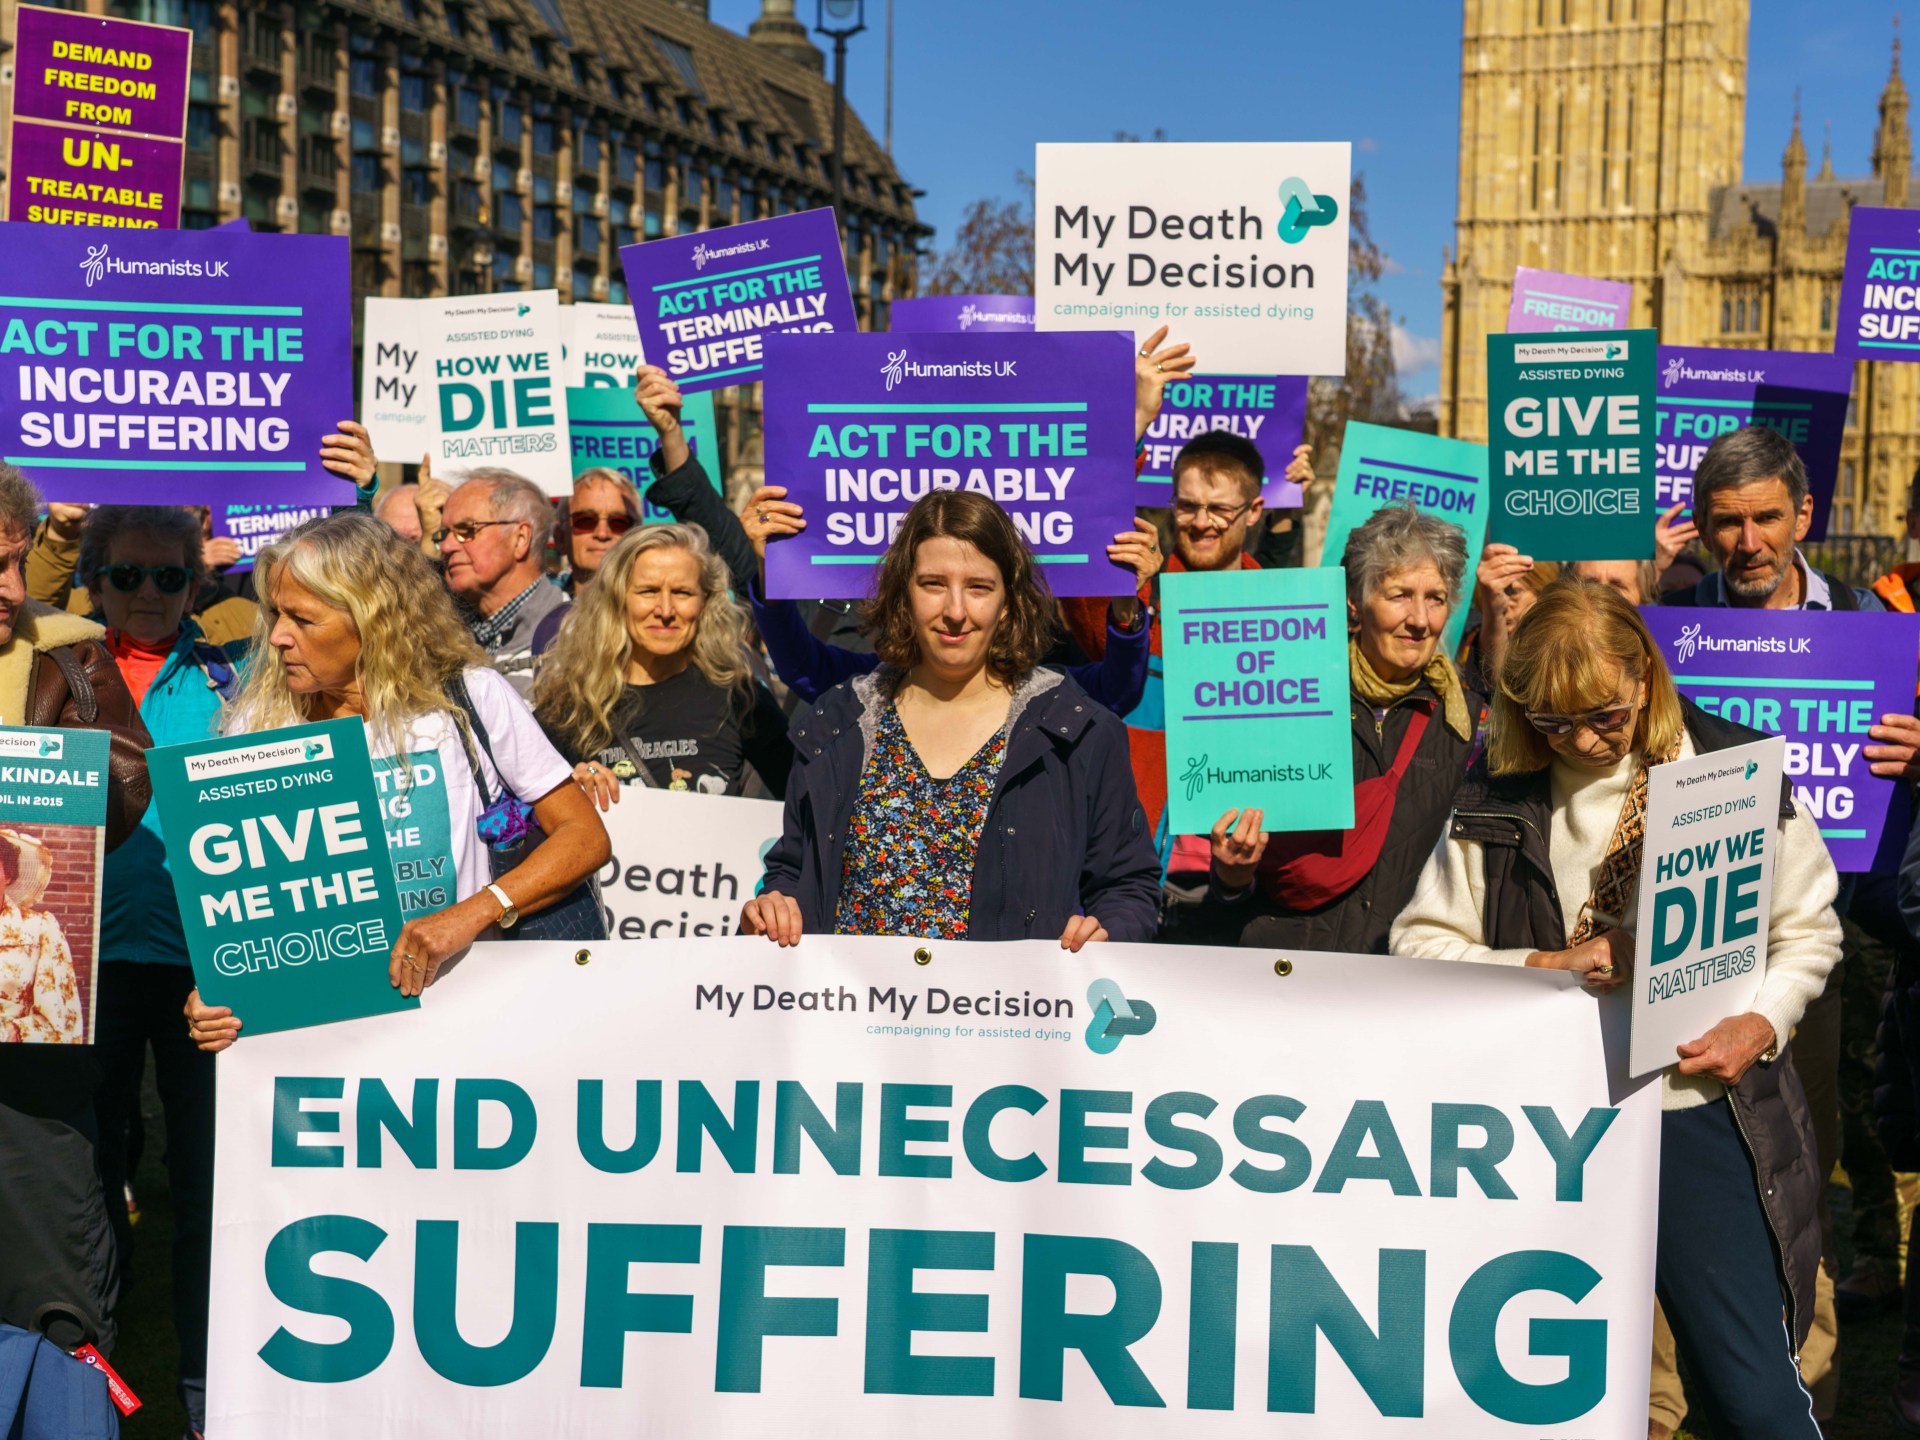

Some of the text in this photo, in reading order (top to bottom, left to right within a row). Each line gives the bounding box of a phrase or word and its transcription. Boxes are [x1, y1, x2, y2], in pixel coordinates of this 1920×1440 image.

[52, 40, 152, 70] DEMAND
[44, 69, 156, 100] FREEDOM
[66, 100, 131, 125] FROM
[62, 138, 133, 171] UN-
[27, 176, 163, 210] TREATABLE
[1054, 206, 1262, 248] My Death
[706, 239, 770, 260] Humanists UK
[106, 256, 229, 278] Humanists UK
[1054, 253, 1314, 295] My Decision
[1867, 257, 1920, 281] ACT
[658, 266, 822, 318] ACT FOR THE
[659, 292, 827, 345] TERMINALLY
[973, 311, 1027, 324] Humanists
[1054, 302, 1314, 320] campaigning for assisted dying
[1523, 298, 1616, 329] FREEDOM
[1, 318, 304, 362] ACT FOR THE
[447, 328, 534, 342] ASSISTED DYING
[595, 332, 639, 342] ASSISTED
[377, 342, 417, 374] My
[436, 352, 549, 378] HOW WE
[585, 352, 638, 369] HOW
[1519, 346, 1603, 356] My Death My Decision
[905, 361, 1017, 377] Humanists UK
[1519, 367, 1624, 380] ASSISTED DYING
[1680, 367, 1765, 383] Humanists UK
[19, 365, 291, 407] INCURABLY
[375, 376, 416, 408] My
[1218, 384, 1276, 408] THE
[438, 377, 554, 433] DIE
[1504, 395, 1640, 438] GIVE
[20, 412, 290, 451] SUFFERING
[443, 433, 557, 458] MATTERS
[808, 423, 1087, 458] ACT FOR THE
[1505, 449, 1558, 476] ME
[1567, 448, 1640, 475] THE
[1354, 473, 1476, 515] FREEDOM
[1505, 488, 1640, 516] CHOICE
[1183, 617, 1326, 644] FREEDOM
[1698, 635, 1811, 653] Humanists UK
[1236, 651, 1275, 674] OF
[1194, 678, 1320, 707] CHOICE
[1790, 699, 1873, 733] THE
[0, 738, 36, 747] ecision
[191, 745, 301, 772] My Death My Decision
[1207, 763, 1333, 784] Humanists UK
[2, 767, 99, 786] KINDALE
[198, 769, 334, 803] ASSISTED DYING
[1676, 765, 1744, 788] My Death My Decision
[17, 795, 31, 806] IN
[33, 796, 63, 806] 2015
[1672, 795, 1756, 828] ASSISTED DYING
[189, 801, 368, 875] GIVE
[1656, 827, 1765, 884] HOW WE
[200, 885, 274, 927] ME
[280, 867, 379, 913] THE
[1650, 863, 1762, 967] DIE
[214, 919, 389, 976] CHOICE
[1648, 945, 1756, 1004] MATTERS
[695, 984, 1074, 1021] My Death My Decision
[866, 1023, 1072, 1043] campaigning for assisted dying
[271, 1076, 1622, 1202] END UNNECESSARY
[257, 1214, 1608, 1426] SUFFERING
